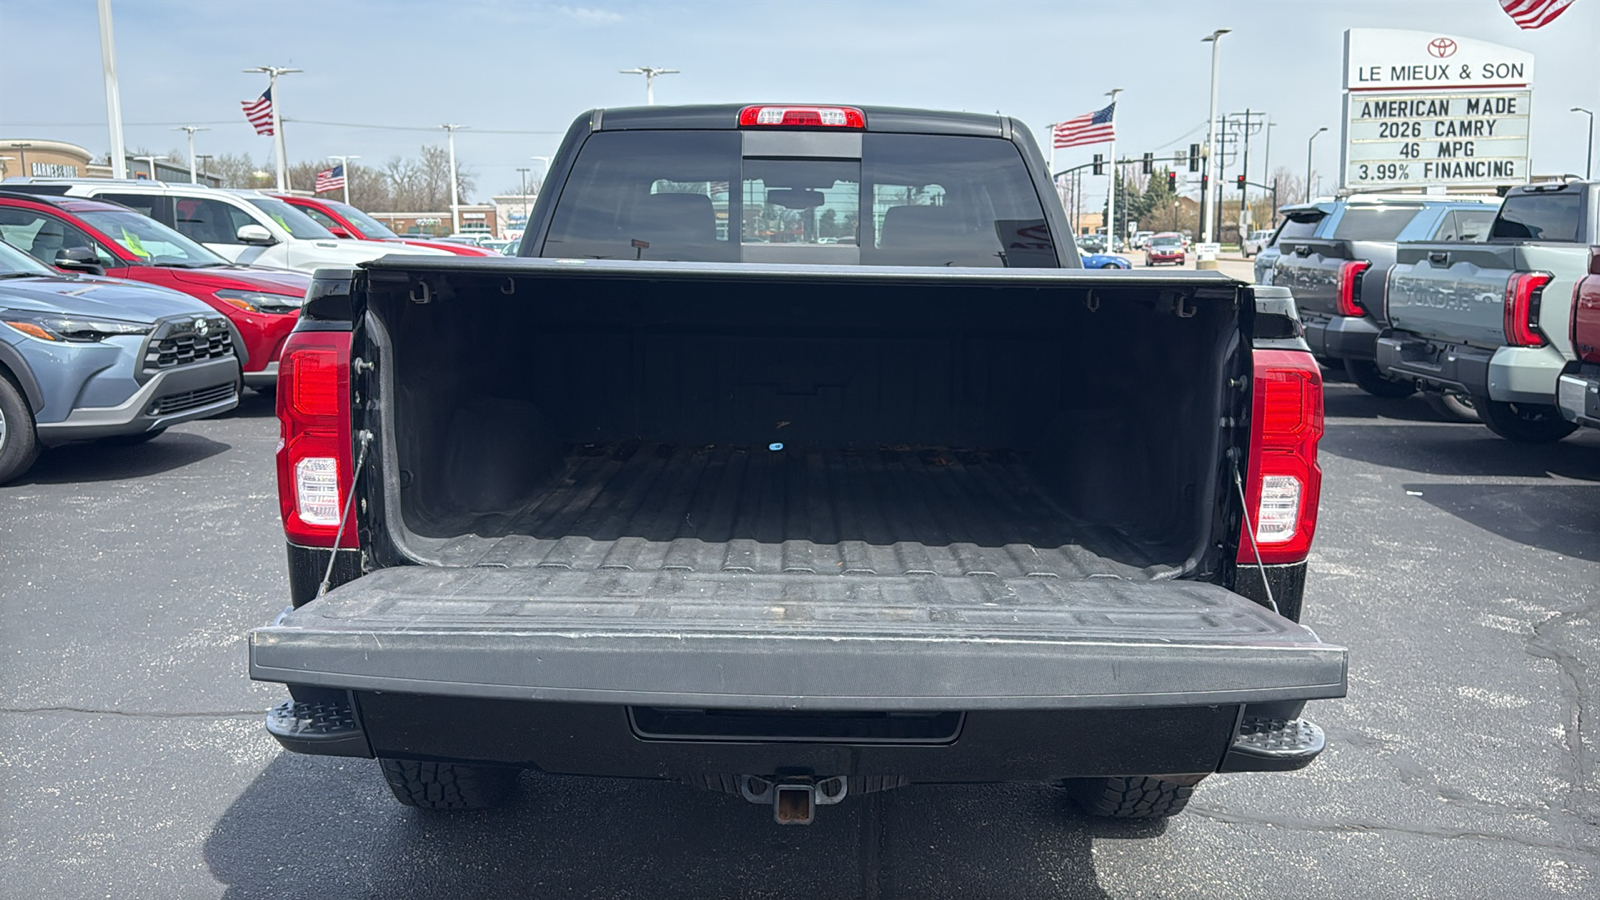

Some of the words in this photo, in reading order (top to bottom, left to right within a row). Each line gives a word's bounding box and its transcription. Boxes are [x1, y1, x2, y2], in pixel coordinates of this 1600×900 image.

[1359, 67, 1381, 82] LE
[1391, 65, 1449, 80] MIEUX
[1459, 65, 1471, 79] &
[1482, 63, 1524, 78] SON
[1361, 100, 1449, 118] AMERICAN
[1467, 98, 1516, 115] MADE
[1380, 122, 1421, 138] 2026
[1435, 119, 1496, 137] CAMRY
[1400, 143, 1419, 158] 46
[1438, 141, 1474, 157] MPG
[1359, 164, 1408, 180] 3.99%
[1424, 161, 1514, 179] FINANCING
